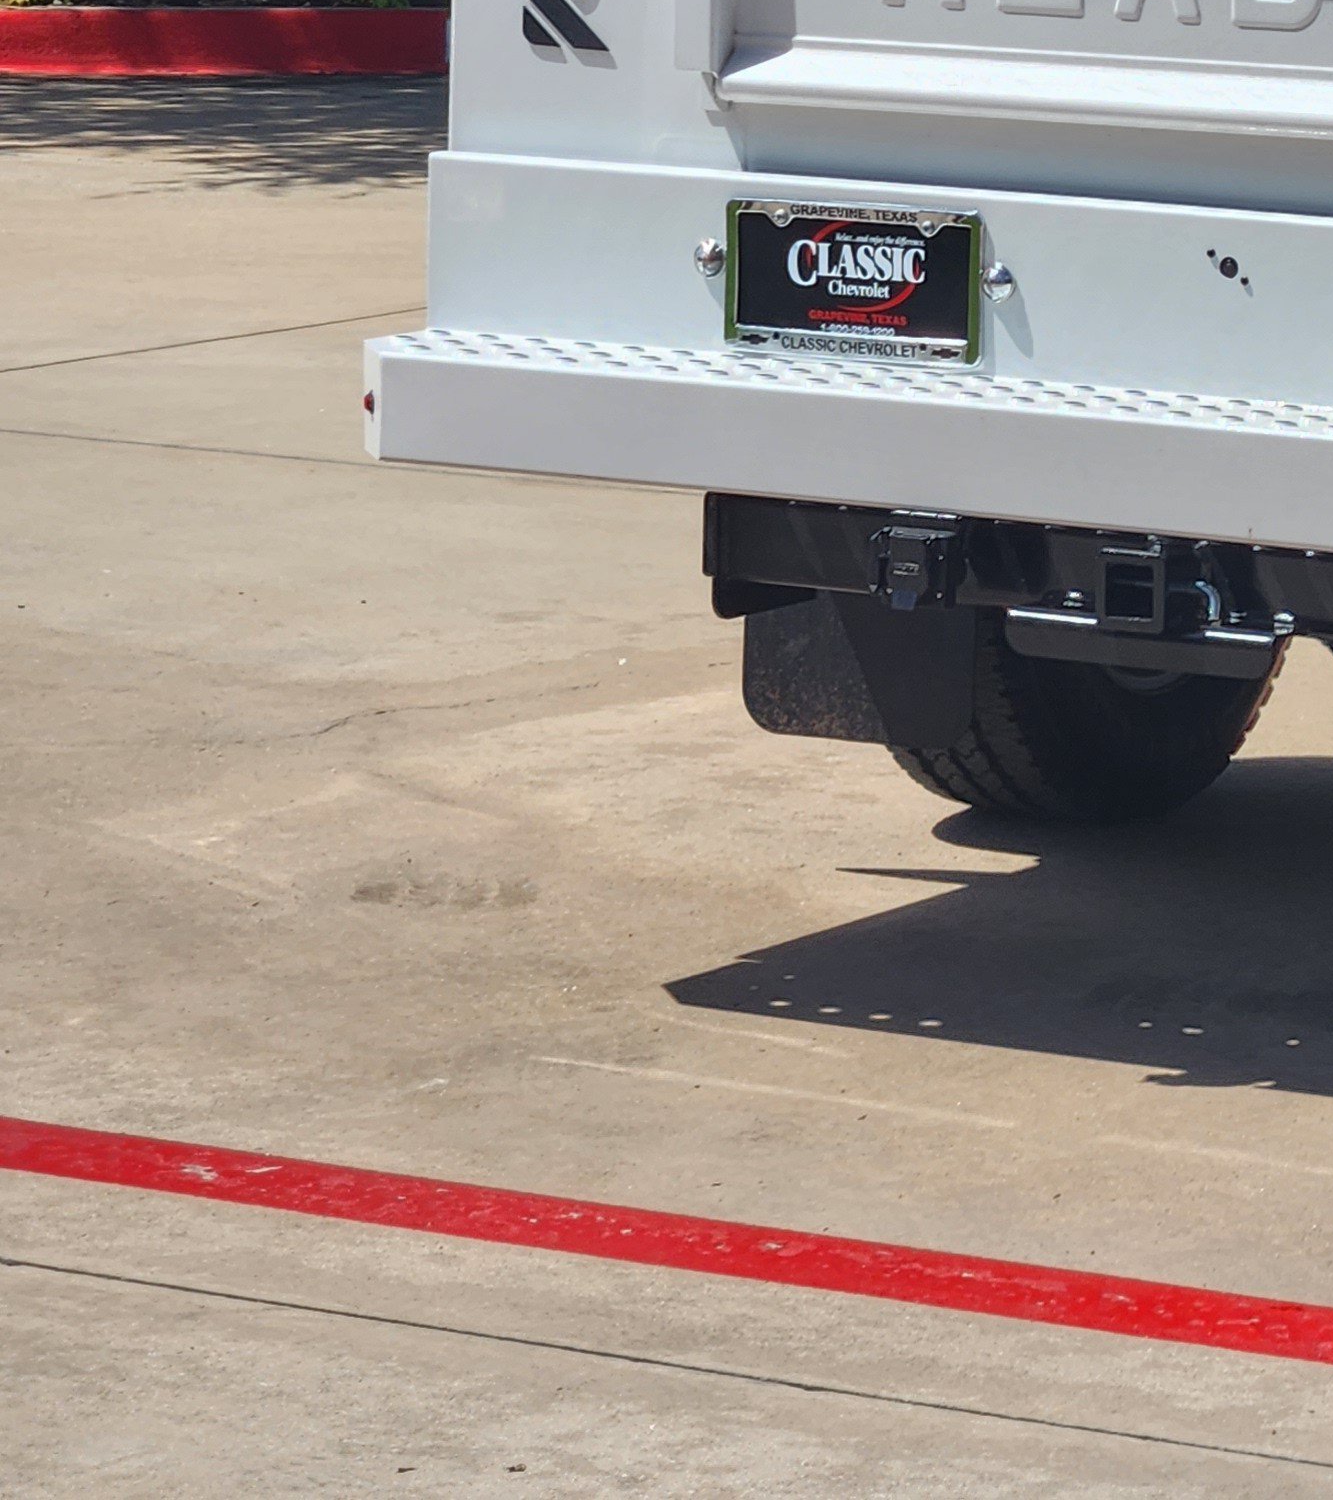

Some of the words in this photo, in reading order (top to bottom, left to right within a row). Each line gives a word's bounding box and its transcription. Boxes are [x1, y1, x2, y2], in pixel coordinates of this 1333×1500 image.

[790, 204, 870, 220] GRAPEVINE,
[873, 209, 918, 223] TEXAS
[787, 240, 926, 286] CLASSIC
[828, 279, 890, 299] Chevrolet
[872, 313, 908, 326] TEXAS
[781, 335, 837, 352] CLASSIC
[839, 339, 917, 358] CHEVROLET
